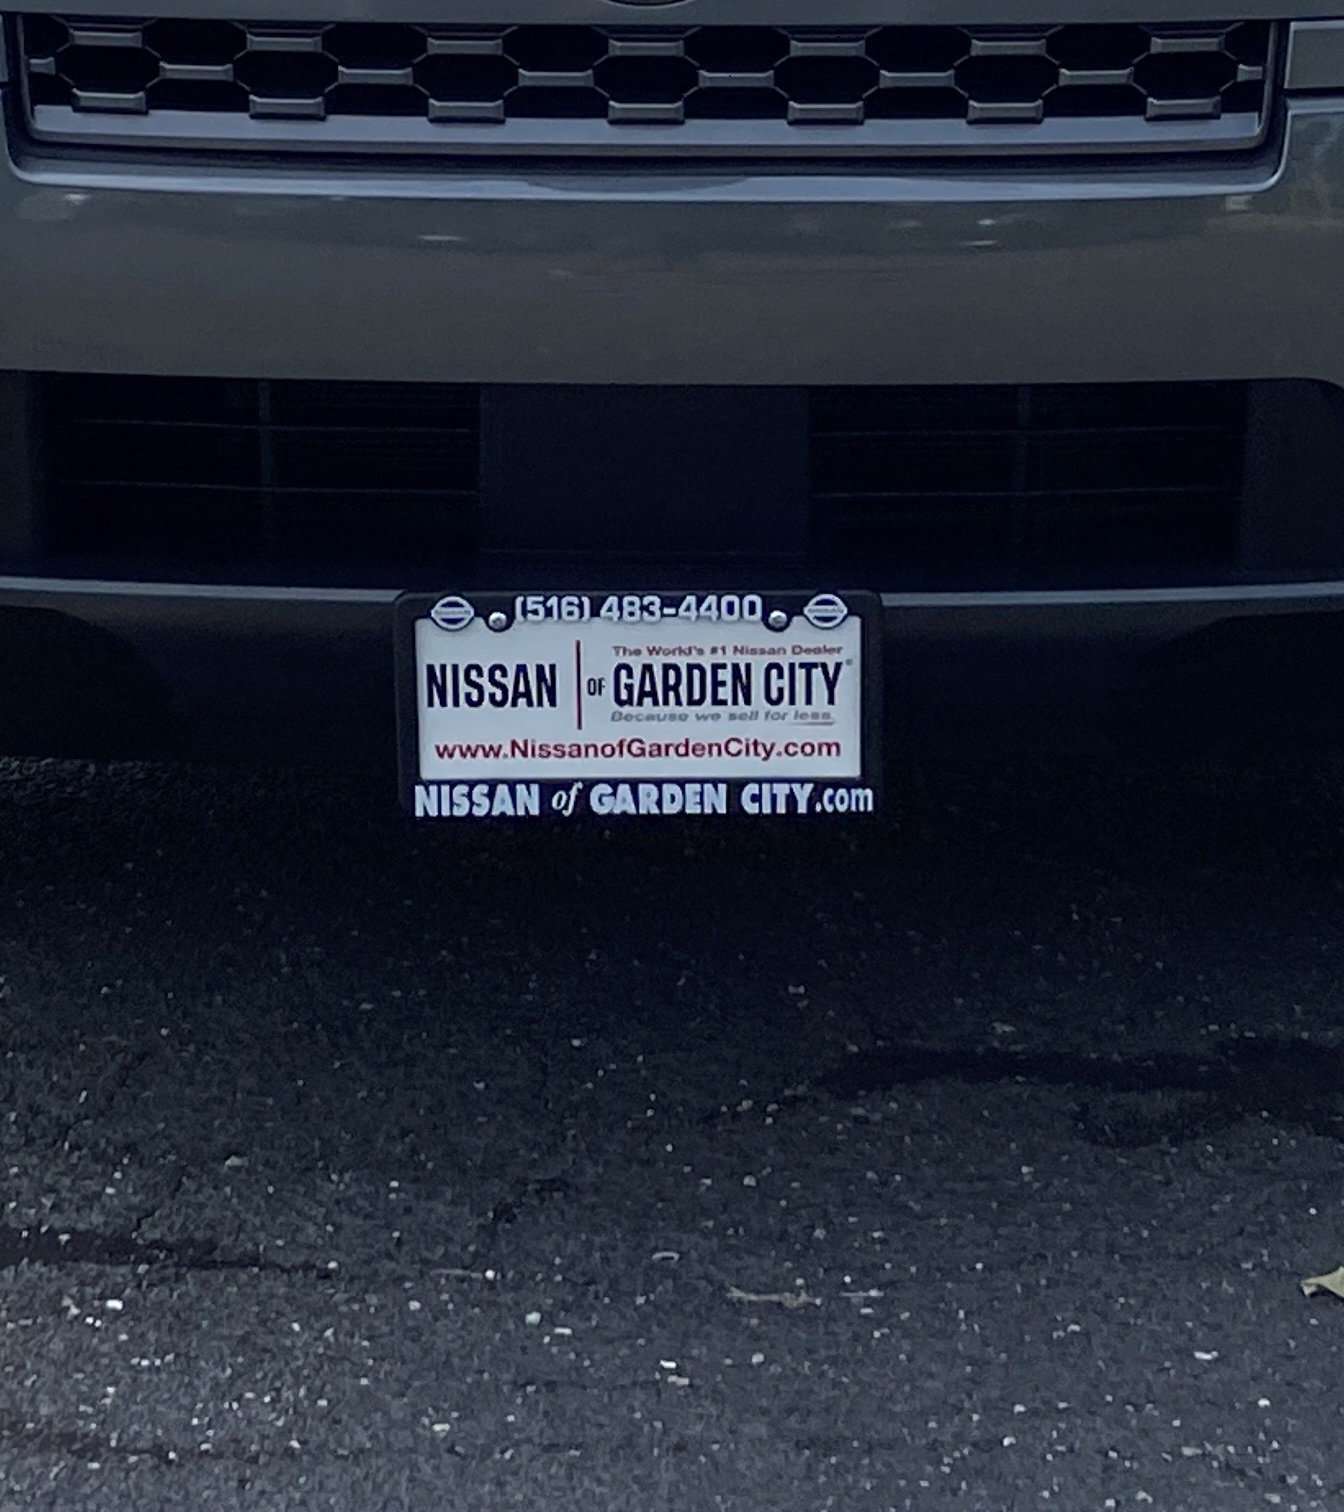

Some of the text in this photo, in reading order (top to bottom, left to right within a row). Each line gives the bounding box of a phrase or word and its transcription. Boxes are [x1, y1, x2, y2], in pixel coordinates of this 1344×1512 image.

[514, 594, 763, 622] (516) 483-4400
[612, 644, 843, 657] The World's #1 Nissan Dealer
[425, 661, 844, 708] NISSAN OF GARDEN CITY
[610, 710, 689, 722] Because
[694, 712, 722, 722] we
[728, 710, 759, 722] sell
[764, 710, 789, 722] for
[434, 737, 841, 762] www.NissanofGardenCity.com
[414, 780, 874, 817] NISSAN of GARDEN CITY.com
